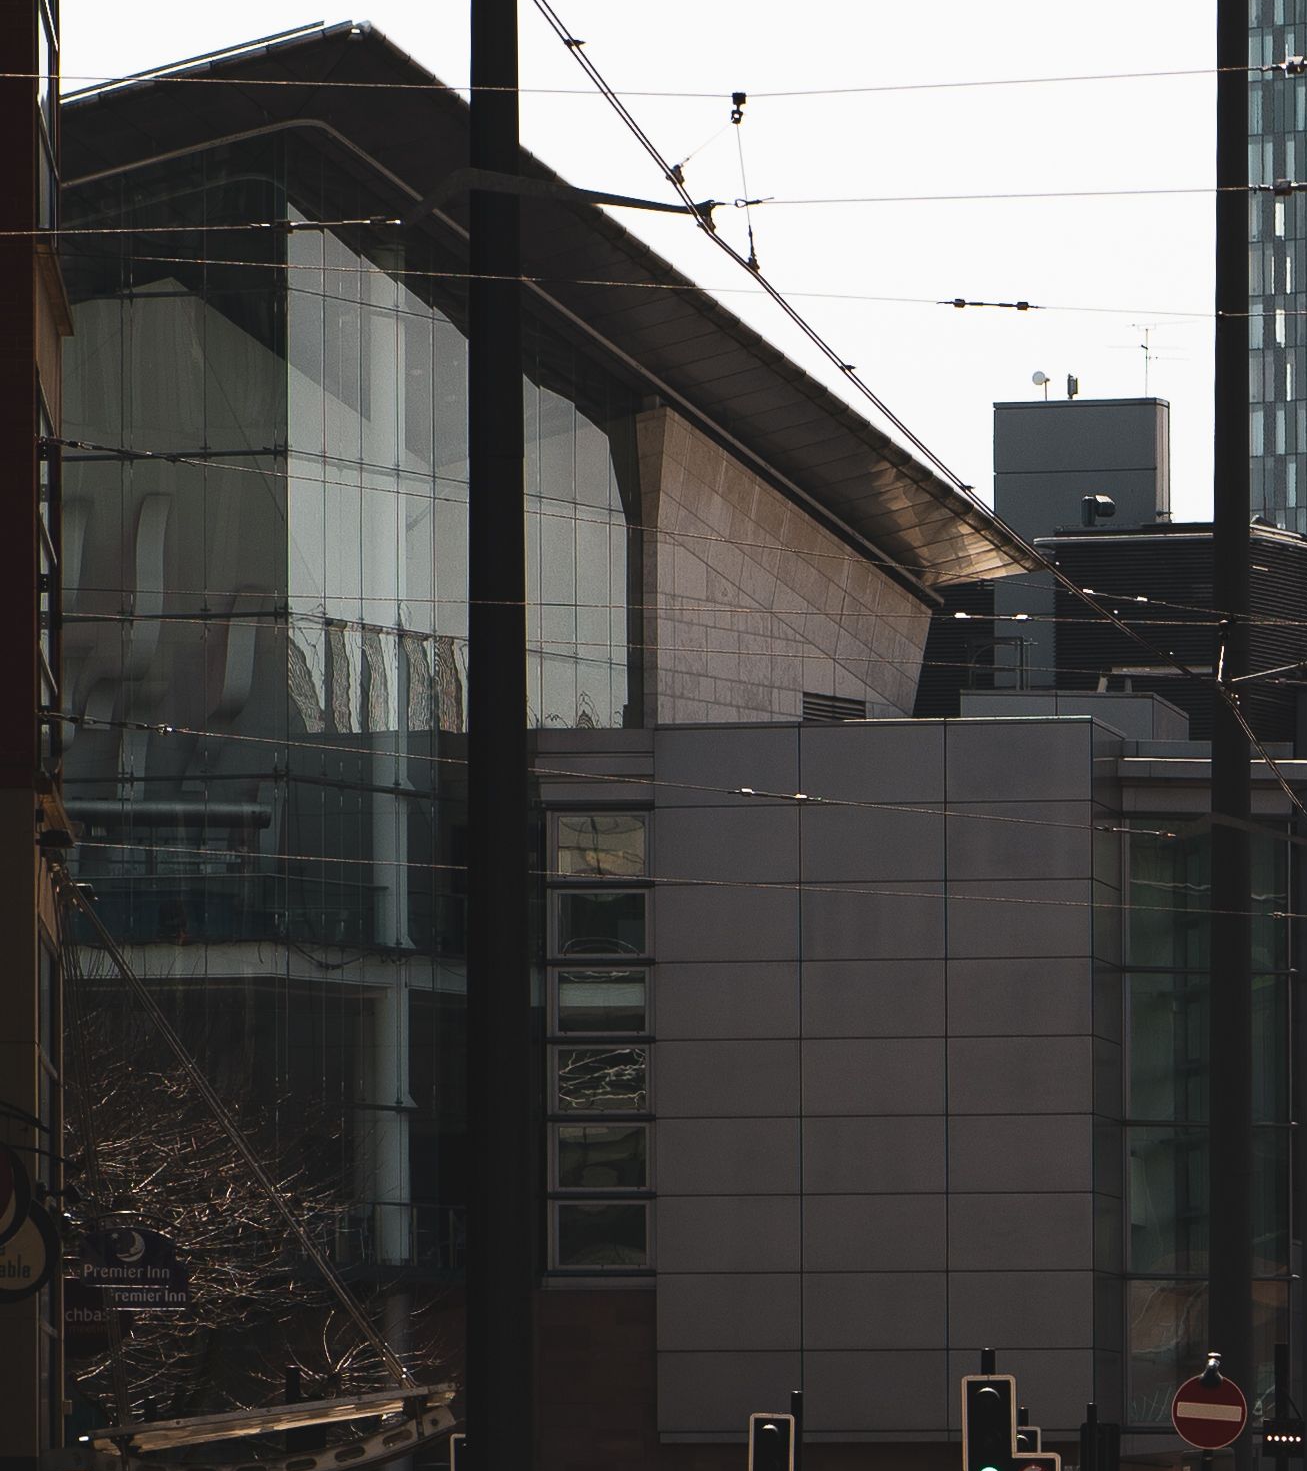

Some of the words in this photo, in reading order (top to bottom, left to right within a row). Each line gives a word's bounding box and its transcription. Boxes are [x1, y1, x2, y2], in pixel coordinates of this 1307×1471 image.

[0, 1254, 30, 1278] able
[84, 1264, 144, 1279] Premier
[147, 1265, 170, 1279] Inn
[112, 1289, 162, 1302] remier
[164, 1291, 187, 1302] Inn
